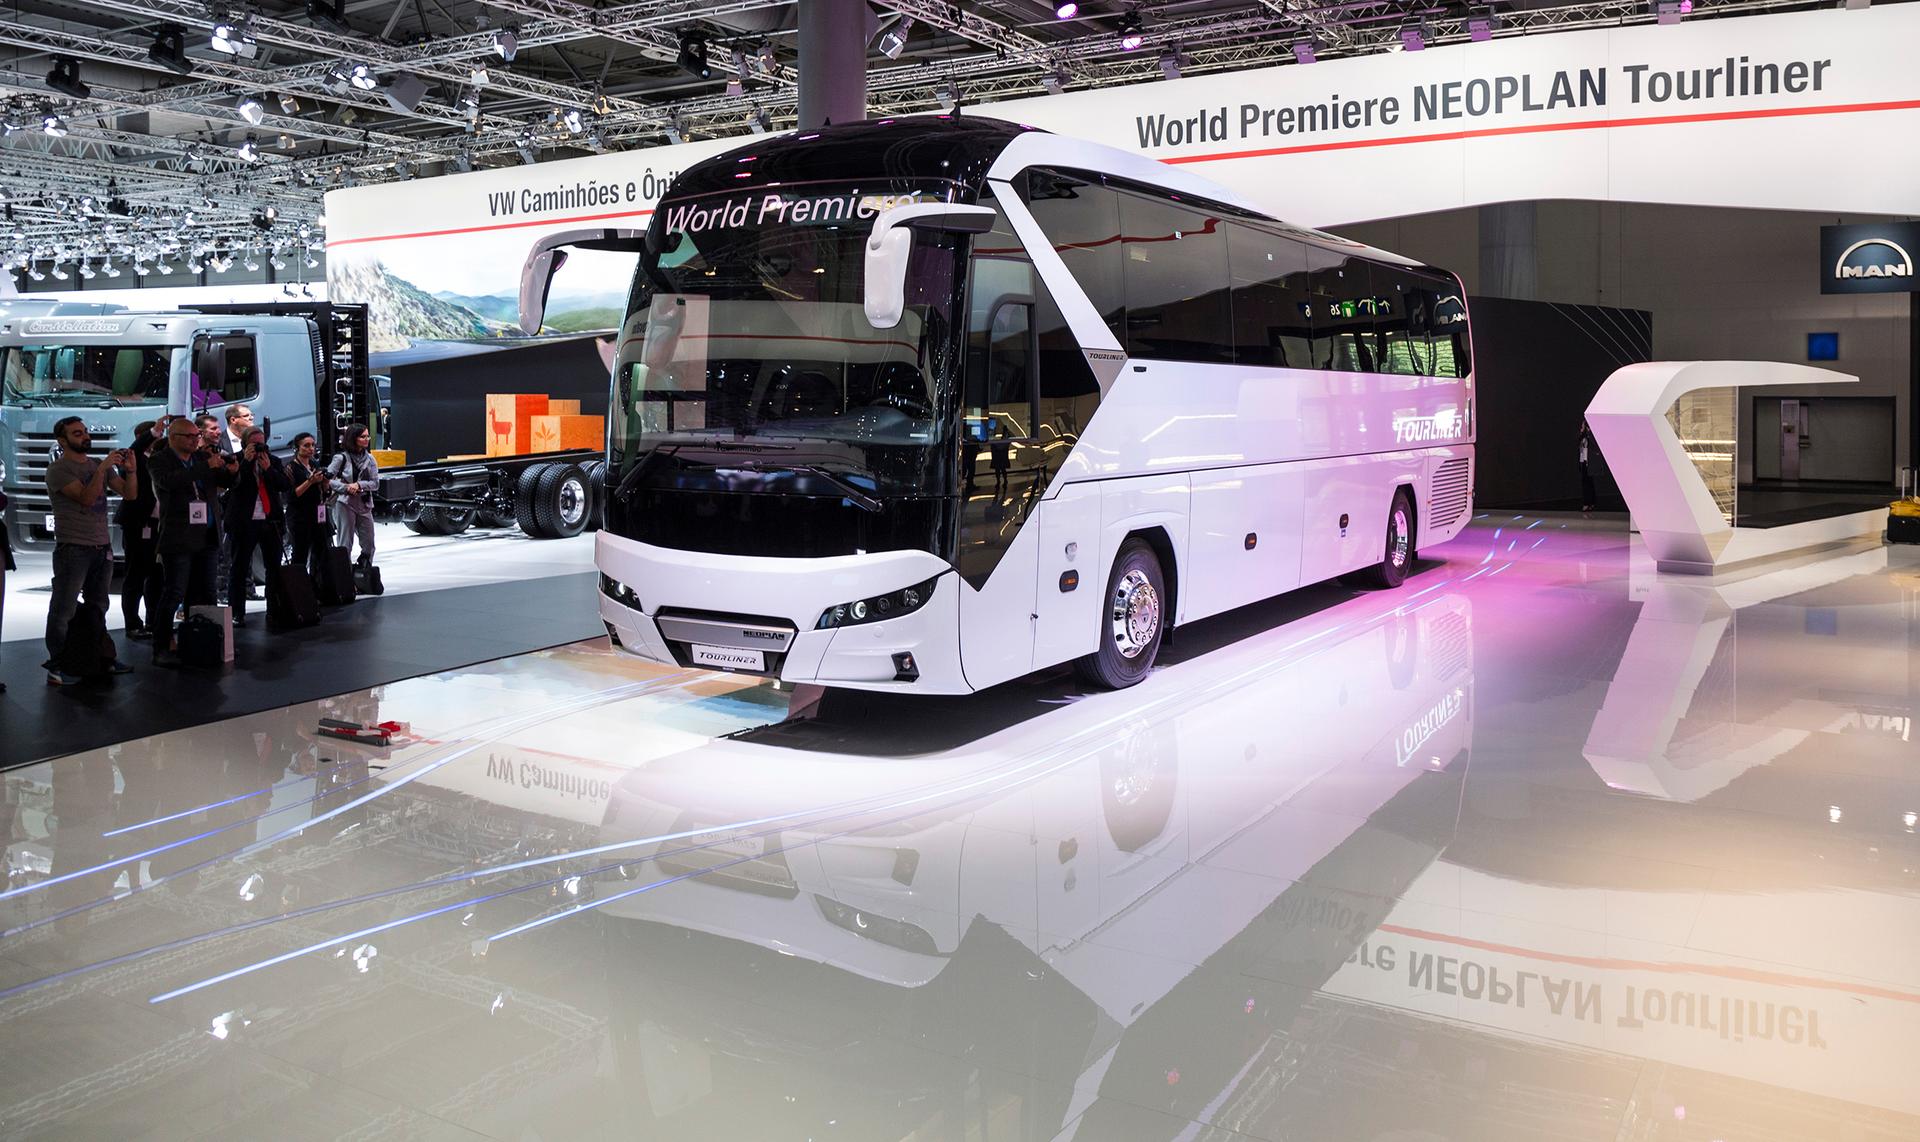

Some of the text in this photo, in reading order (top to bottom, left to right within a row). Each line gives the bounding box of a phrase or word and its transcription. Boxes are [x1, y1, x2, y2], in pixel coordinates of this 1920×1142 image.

[1136, 55, 1831, 148] World Premiere NEOPLAN Tourliner
[488, 190, 516, 216] VW
[521, 180, 619, 213] Caminhões
[626, 182, 636, 202] e
[665, 197, 752, 236] World
[1842, 263, 1906, 278] MAN
[28, 320, 120, 333] Constellation
[1089, 352, 1124, 361] TOURLINER
[1395, 414, 1462, 443] TOURLINER
[743, 630, 785, 641] NEOPLAN
[699, 651, 757, 664] TOURLINER
